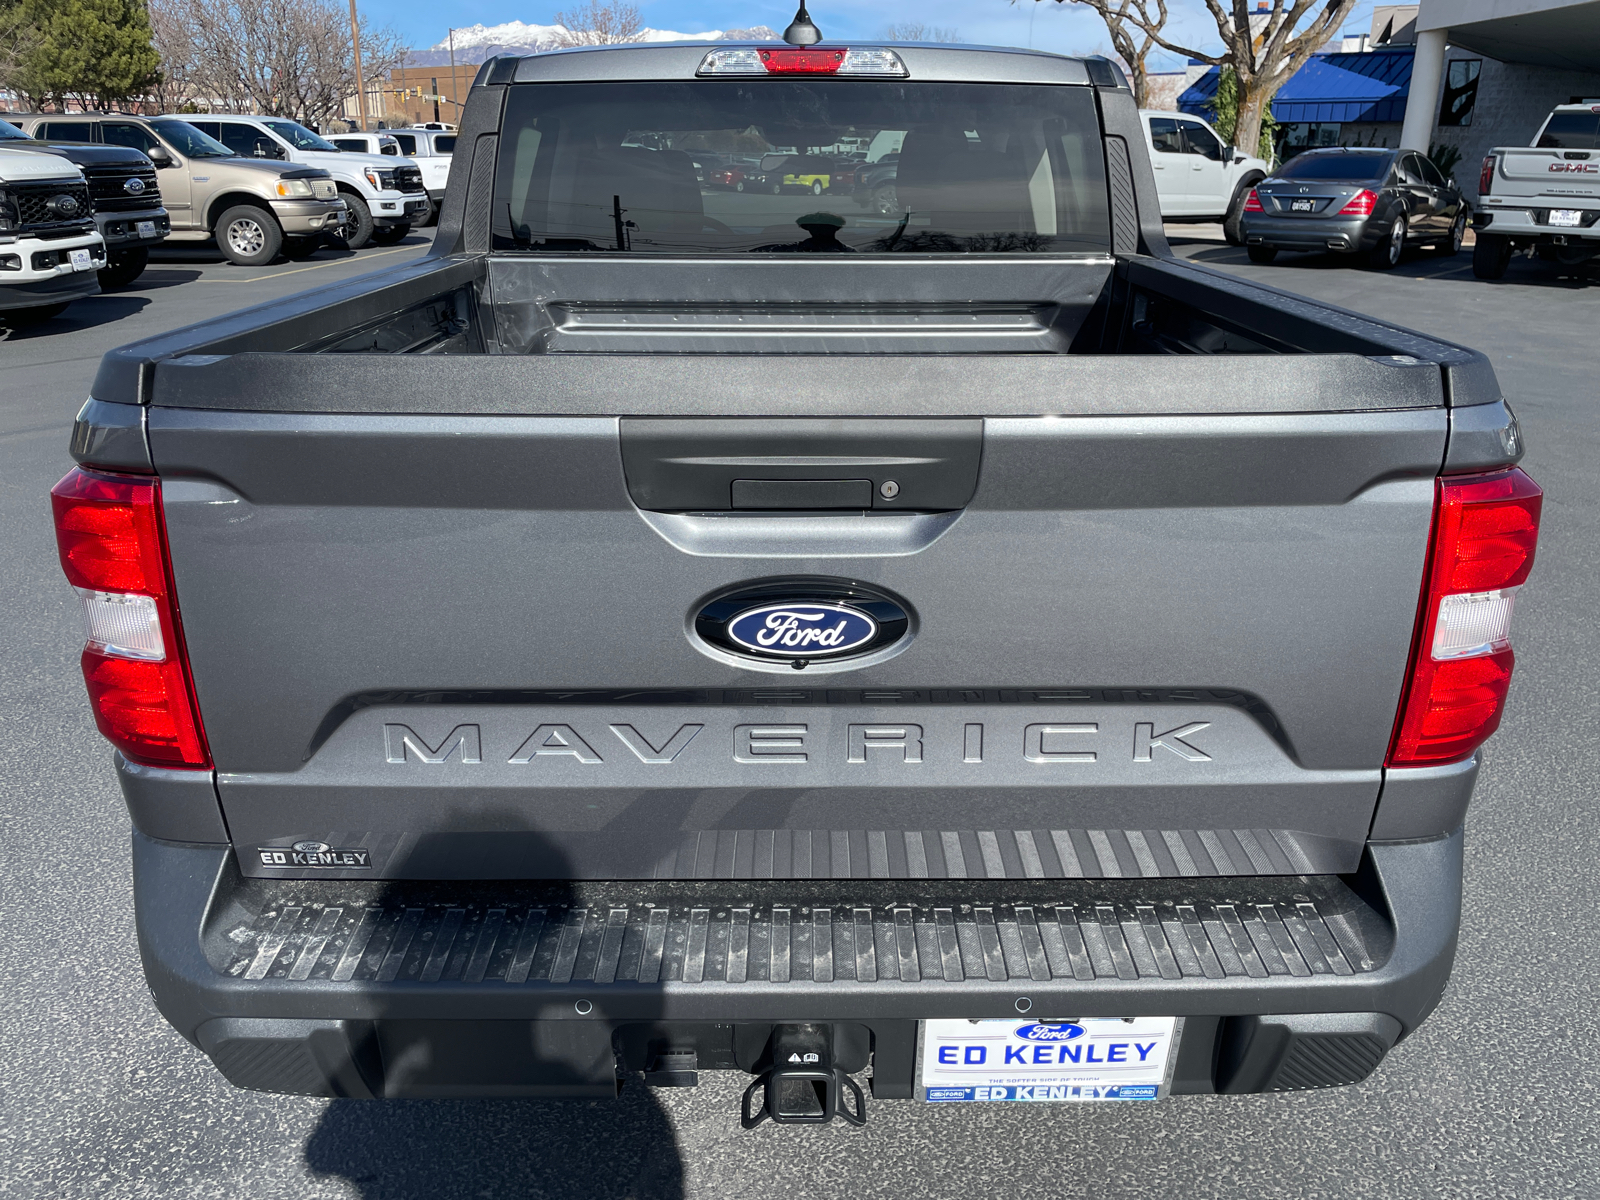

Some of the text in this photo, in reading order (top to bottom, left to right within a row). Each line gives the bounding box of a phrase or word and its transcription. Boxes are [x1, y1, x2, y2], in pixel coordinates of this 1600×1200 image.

[1549, 163, 1599, 173] GMC
[756, 611, 847, 647] Ford
[384, 722, 1213, 765] MAVERICK
[301, 843, 322, 852] Ford
[260, 852, 367, 865] ED KENLEY
[1027, 1024, 1072, 1041] Ford
[938, 1042, 1158, 1065] ED KENLEY
[974, 1087, 1008, 1100] ED
[1015, 1086, 1112, 1100] KENLEY
